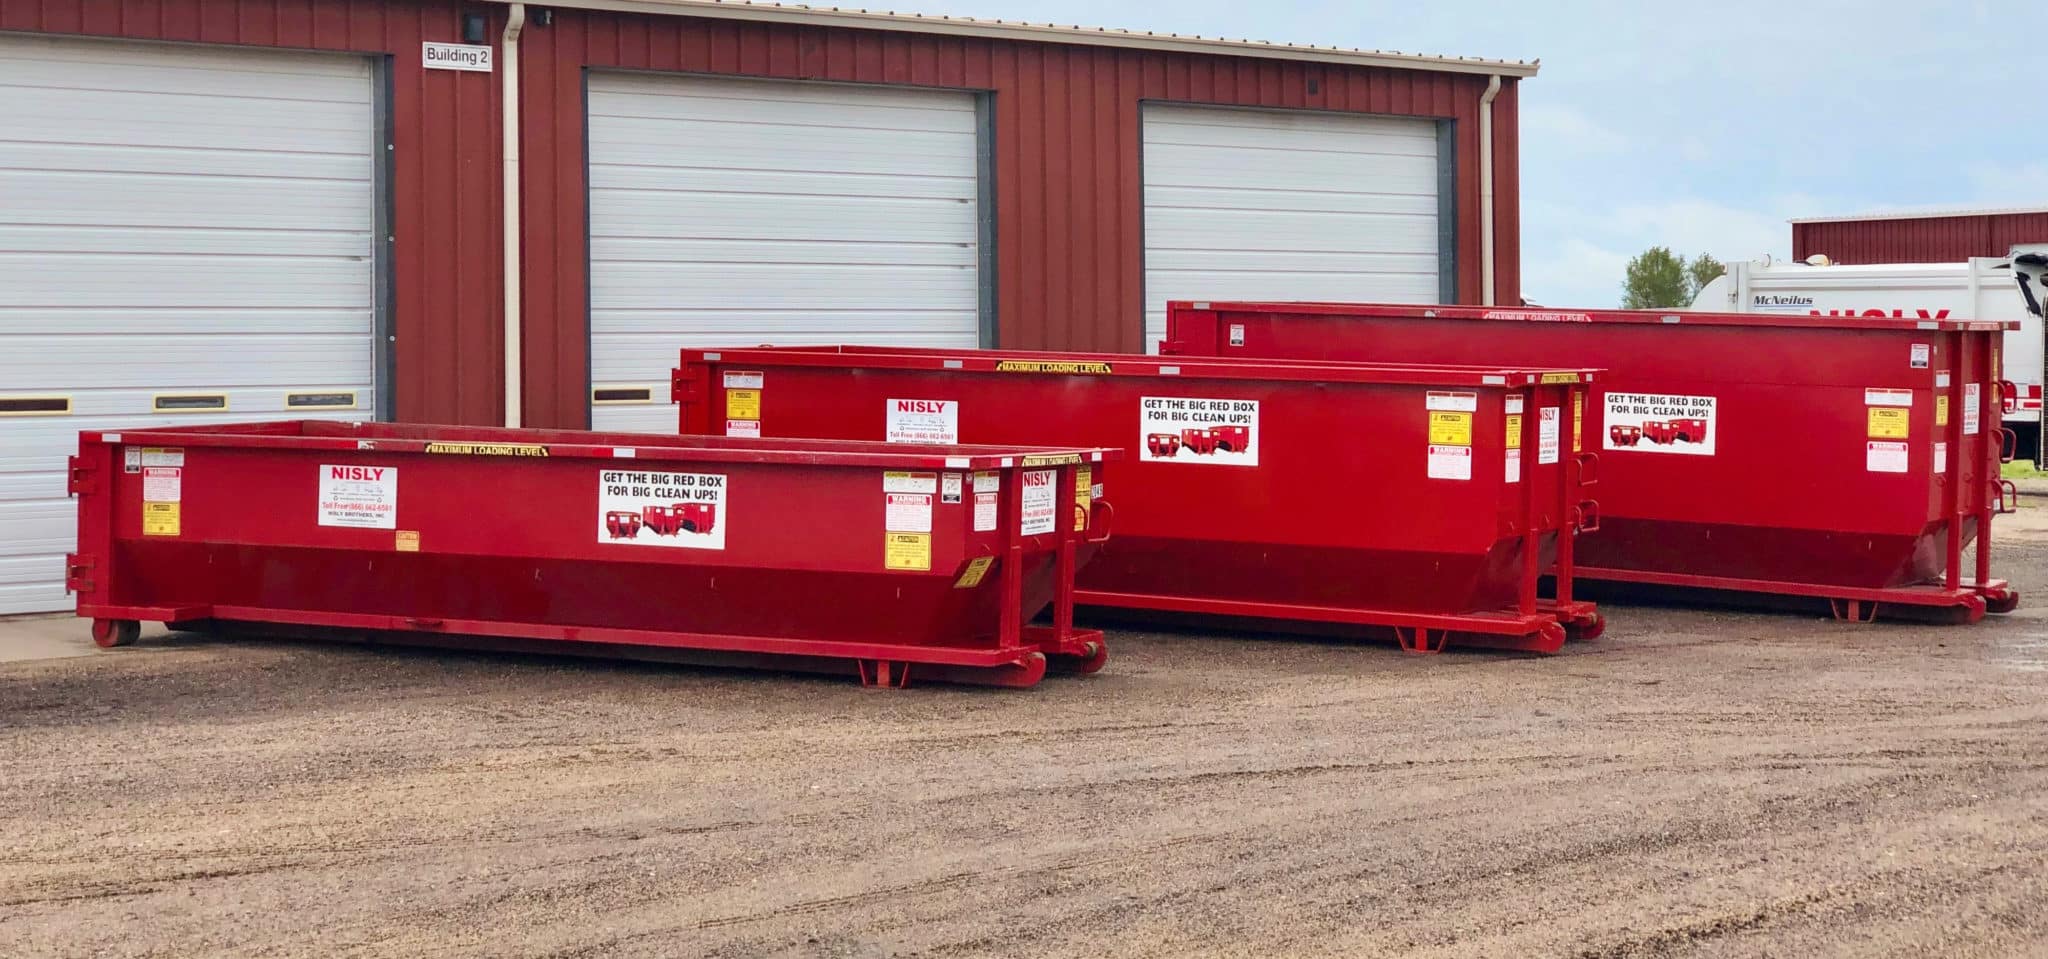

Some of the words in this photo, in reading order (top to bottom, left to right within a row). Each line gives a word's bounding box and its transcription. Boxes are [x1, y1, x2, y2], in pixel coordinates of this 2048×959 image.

[427, 47, 477, 65] Building
[480, 51, 488, 63] 2
[1754, 295, 1814, 305] McNeilus
[1488, 312, 1525, 320] MAXIMUM
[1002, 362, 1041, 372] MAXIMUM
[1042, 363, 1078, 373] LOADING
[1080, 364, 1106, 373] LEVEL
[897, 400, 945, 414] NISLY
[1144, 399, 1163, 409] GET
[1165, 400, 1185, 410] THE
[1189, 401, 1206, 410] BIG
[1209, 401, 1230, 411] RED
[1233, 402, 1255, 412] BOX
[1607, 394, 1626, 403] GET
[1628, 395, 1646, 404] THE
[1649, 396, 1666, 405] BIG
[1669, 397, 1689, 406] RED
[1692, 398, 1713, 407] BOX
[1148, 411, 1168, 420] FOR
[1171, 411, 1188, 421] BIG
[1192, 412, 1226, 423] CLEAN
[1229, 414, 1251, 424] UPS!
[1611, 405, 1630, 414] FOR
[1633, 406, 1649, 415] BIG
[1652, 407, 1684, 416] CLEAN
[1687, 408, 1709, 417] UPS!
[430, 444, 472, 454] MAXIMUM
[474, 446, 514, 456] LOADING
[514, 447, 542, 457] LEVEL
[331, 466, 385, 481] NISLY
[603, 472, 624, 483] GET
[626, 473, 648, 484] THE
[651, 474, 670, 485] BIG
[673, 475, 695, 486] RED
[699, 476, 722, 487] BOX
[1023, 471, 1051, 487] NISLY
[607, 486, 628, 496] FOR
[632, 486, 651, 497] BIG
[654, 487, 690, 499] CLEAN
[694, 489, 718, 500] UPS!
[322, 501, 333, 509] Toll
